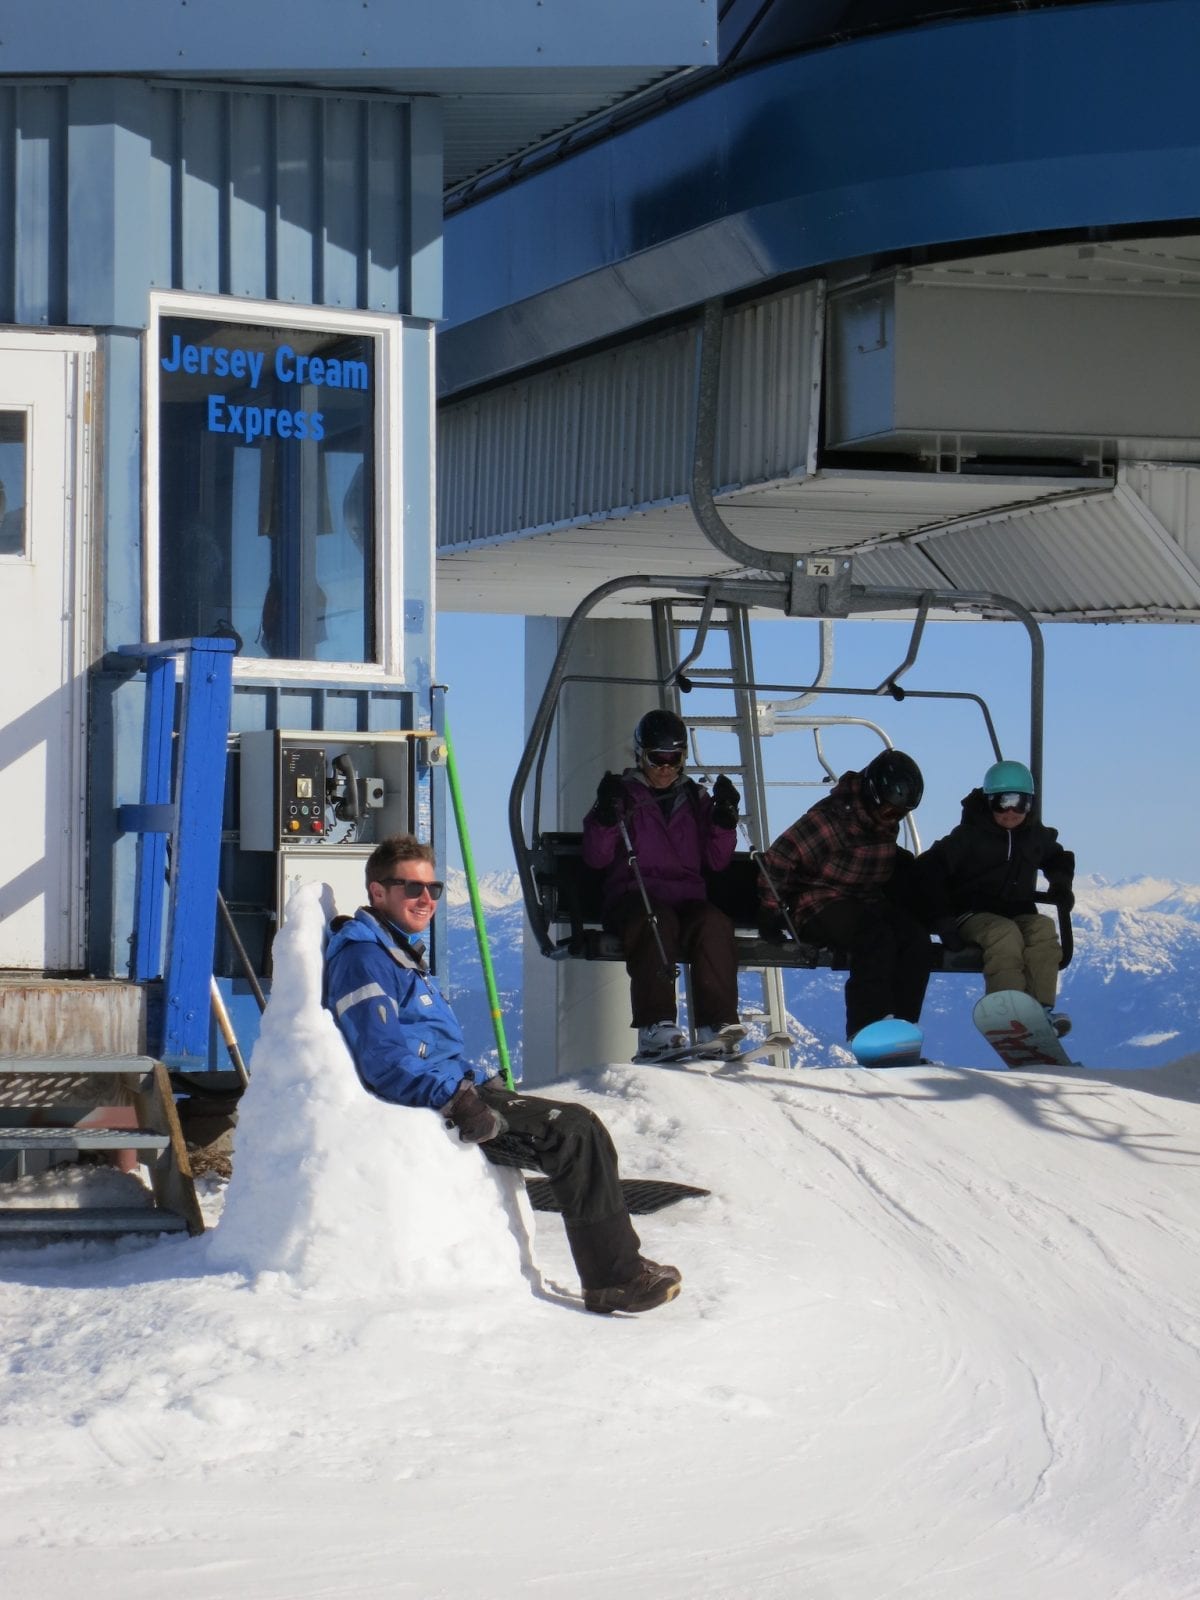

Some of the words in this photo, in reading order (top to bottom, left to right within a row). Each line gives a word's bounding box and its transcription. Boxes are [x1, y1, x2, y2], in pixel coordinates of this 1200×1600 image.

[161, 335, 264, 388] Jersey
[275, 344, 368, 389] Cream
[208, 394, 325, 443] Express
[813, 565, 830, 575] 74
